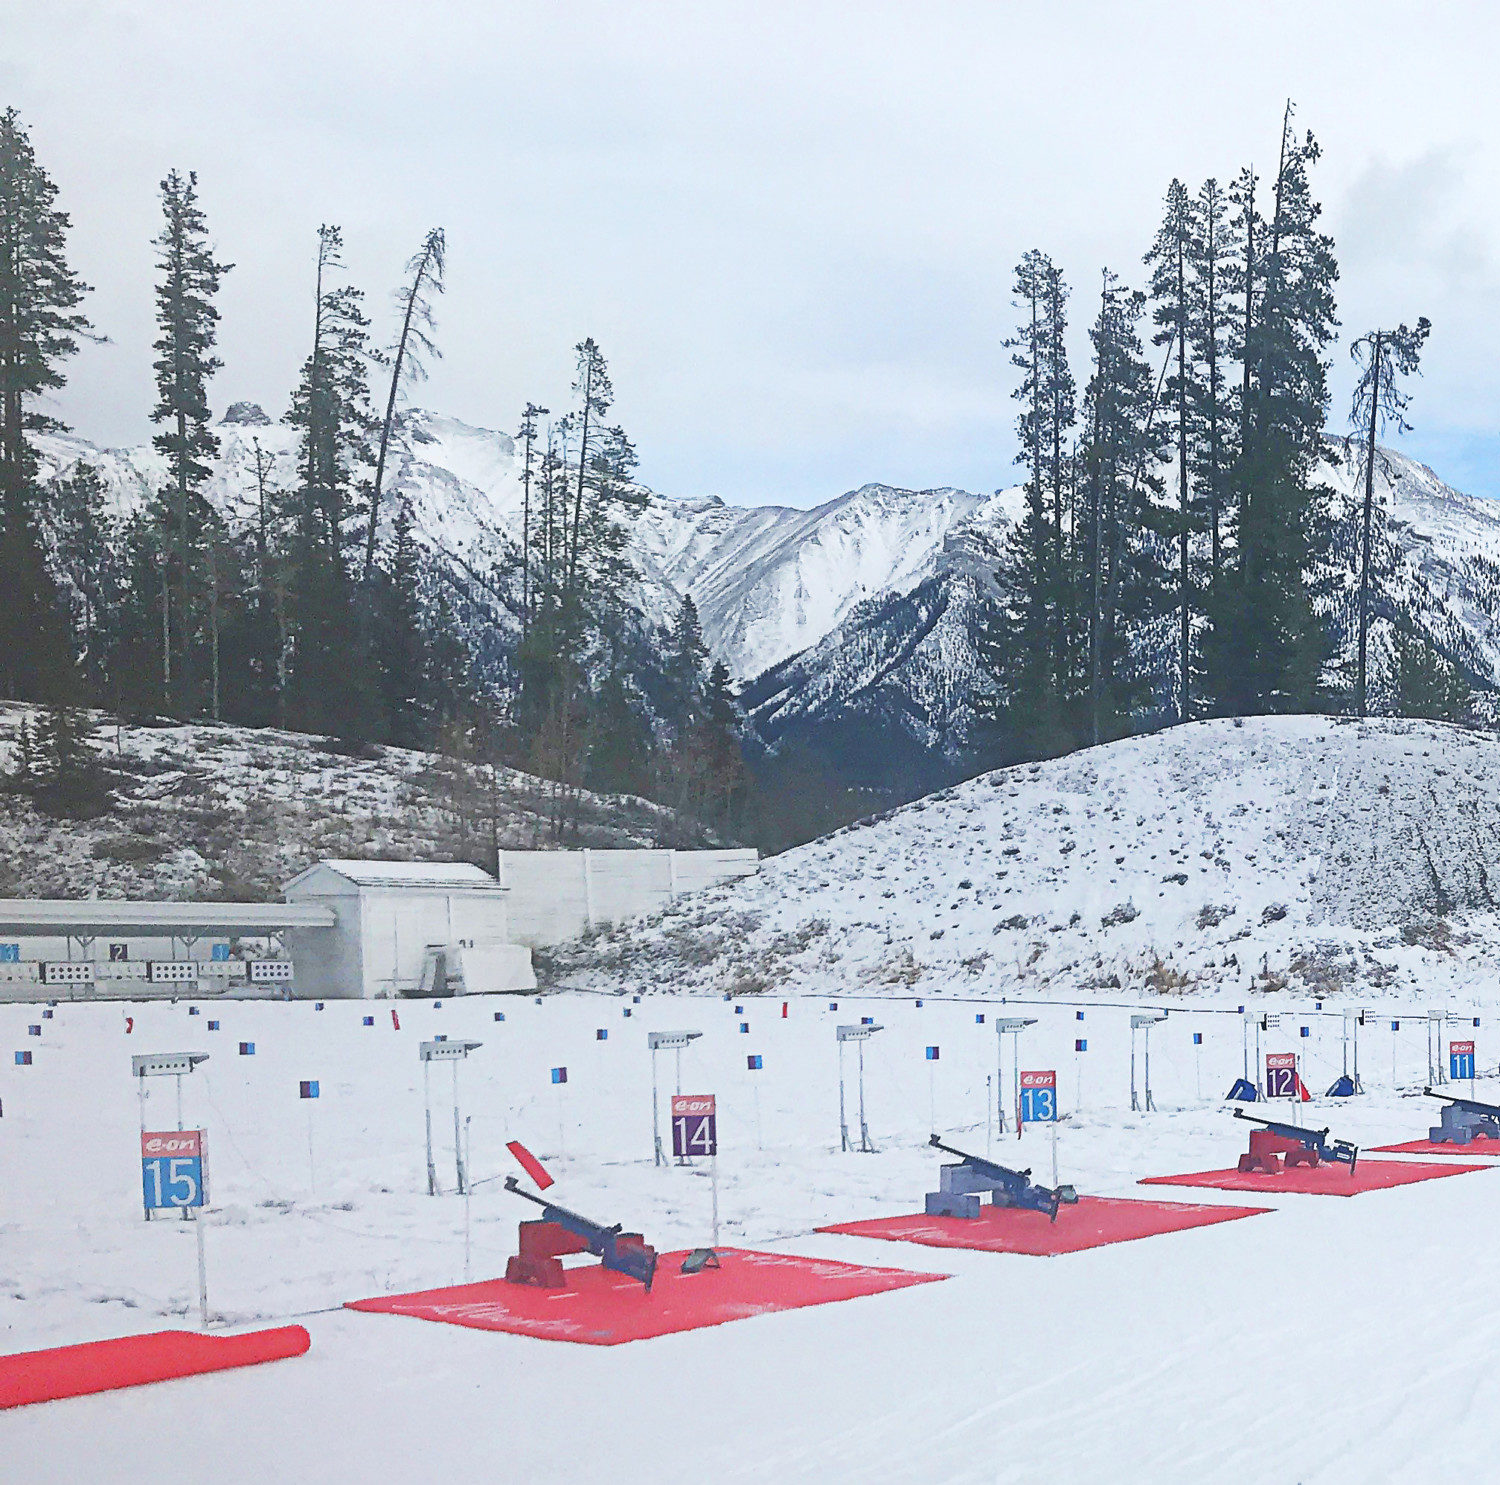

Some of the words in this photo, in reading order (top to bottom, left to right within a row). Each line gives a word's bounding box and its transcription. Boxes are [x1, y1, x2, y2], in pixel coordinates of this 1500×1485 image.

[1453, 1054, 1470, 1078] 11
[1268, 1069, 1293, 1096] 12
[1024, 1089, 1053, 1120] 13
[675, 1115, 713, 1155] 14
[146, 1159, 197, 1206] 15
